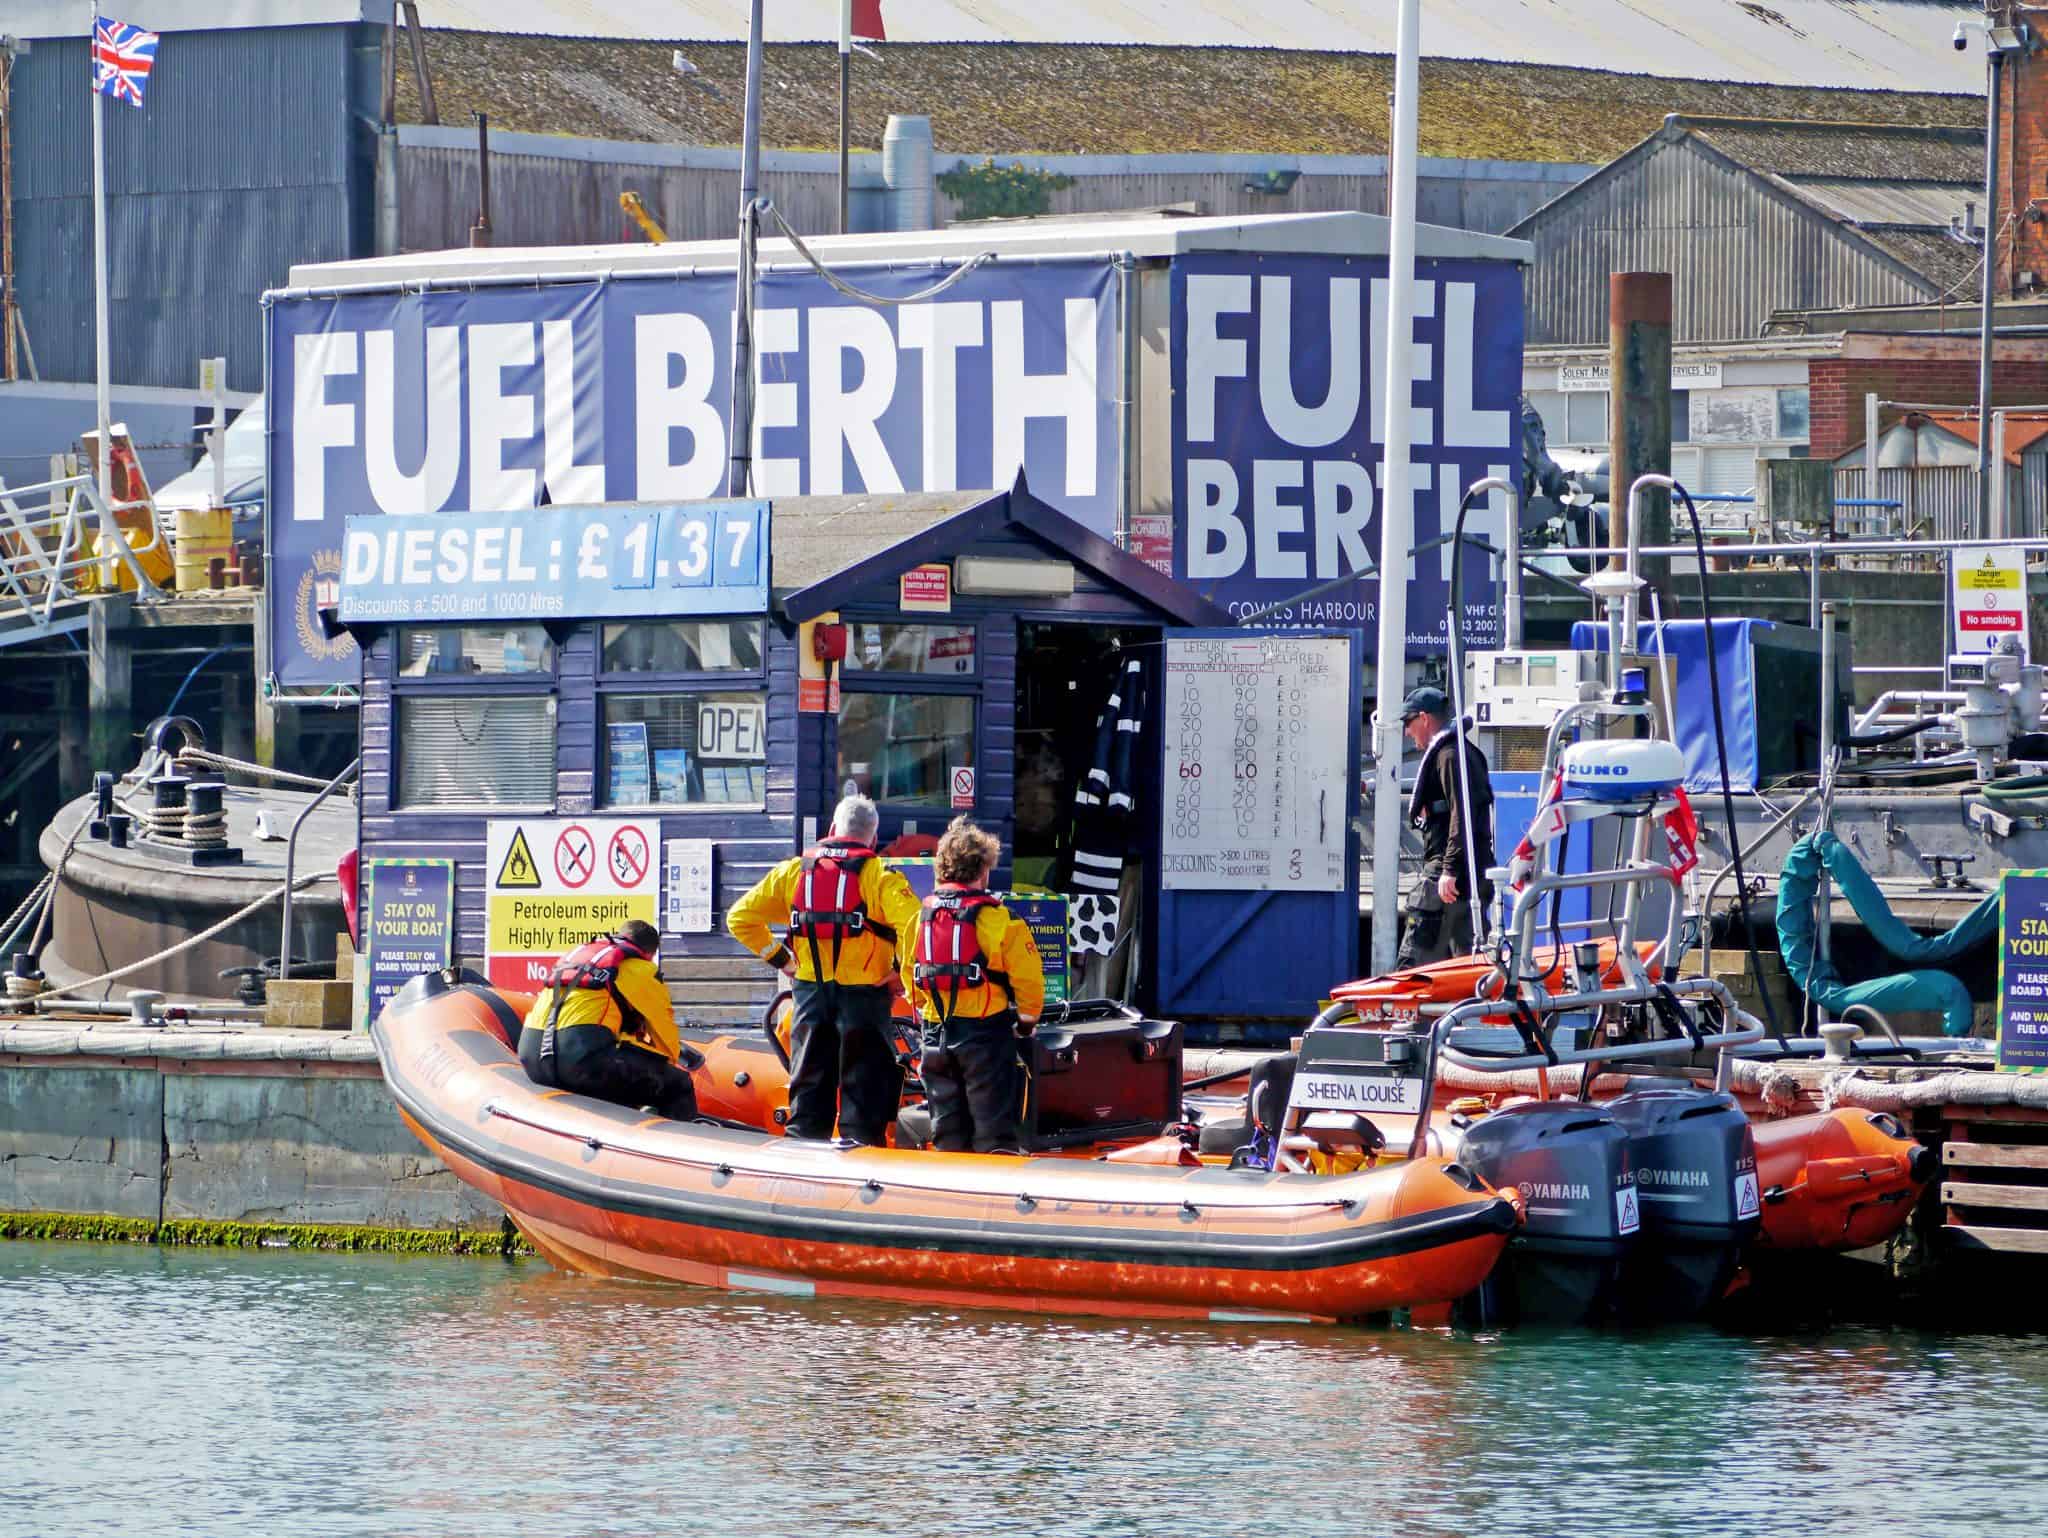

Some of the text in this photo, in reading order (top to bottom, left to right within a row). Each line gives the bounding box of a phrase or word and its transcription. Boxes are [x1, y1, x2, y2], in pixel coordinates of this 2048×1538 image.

[1186, 274, 1510, 448] FUEL
[1562, 367, 1588, 378] SOLENT
[1592, 366, 1609, 378] MAR
[1672, 365, 1700, 377] ERVICES
[293, 297, 1097, 521] FUEL BERTH
[1187, 460, 1510, 582] BERTH
[342, 593, 409, 617] Discounts
[430, 594, 459, 614] 500
[462, 593, 487, 613] and
[493, 593, 526, 613] 1000
[529, 592, 564, 612] litres
[1228, 602, 1375, 621] COWES HARBOUR
[1465, 604, 1485, 616] VHF
[1966, 615, 2016, 627] No smoking
[1184, 673, 1196, 685] 0
[1231, 672, 1259, 686] 100
[1184, 688, 1200, 702] 10
[1235, 688, 1257, 701] 90
[1180, 703, 1202, 717] 20
[1234, 703, 1257, 717] 80
[1480, 704, 1487, 721] 4
[1180, 718, 1202, 733] 30
[1235, 718, 1258, 736] 70
[1235, 733, 1256, 747] 60
[1180, 749, 1201, 762] 50
[1234, 749, 1256, 762] 50
[1179, 763, 1202, 779] 60
[1234, 763, 1258, 779] 40
[1180, 779, 1201, 793] 70
[1234, 779, 1257, 793] 30
[1176, 794, 1201, 809] 80
[1233, 794, 1257, 809] 20
[1175, 809, 1200, 823] 90
[1235, 809, 1255, 823] 10
[1171, 824, 1200, 839] 100
[1237, 824, 1249, 838] 0
[384, 903, 436, 919] STAY ON
[514, 901, 629, 923] Petroleum spirit
[375, 920, 444, 937] YOUR BOAT
[2021, 919, 2048, 936] STA
[509, 928, 554, 949] Highly
[381, 951, 436, 961] PLEASE STAY ON
[375, 962, 399, 972] BOARD
[401, 962, 420, 972] YOUR
[526, 961, 548, 981] No
[2017, 972, 2048, 984] PLEASE
[375, 985, 391, 995] AND
[2010, 985, 2042, 996] BOARD
[2010, 1011, 2032, 1022] AND
[2017, 1024, 2038, 1034] FUEL
[1307, 1081, 1405, 1103] SHEENA LOUISE
[1736, 1156, 1754, 1171] 115
[1616, 1169, 1710, 1187] 115 YAMAHA
[1533, 1183, 1590, 1200] YAMAHA
